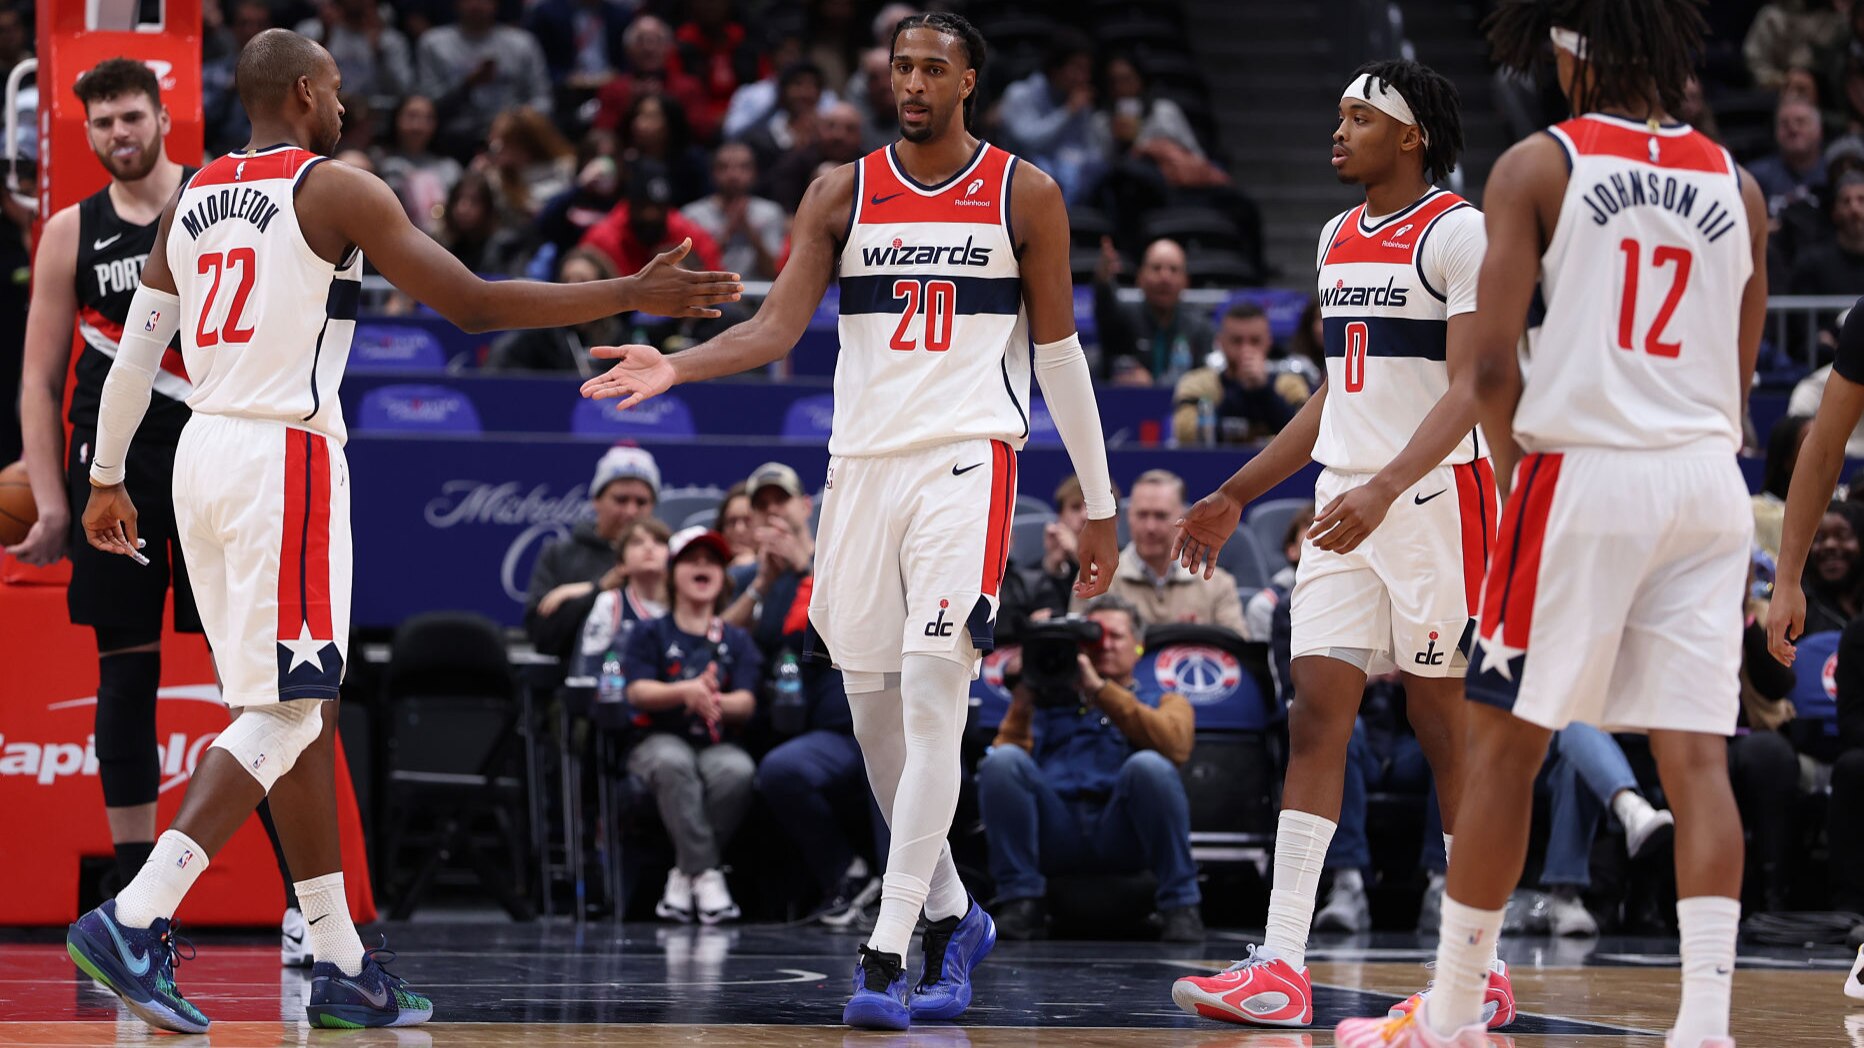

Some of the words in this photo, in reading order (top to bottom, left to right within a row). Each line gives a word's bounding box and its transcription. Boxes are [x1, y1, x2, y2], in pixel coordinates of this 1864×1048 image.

[181, 187, 279, 241] MIDDLETON
[955, 199, 991, 207] Robinhood
[1583, 170, 1697, 226] JOHNSON
[1697, 201, 1735, 243] III
[863, 235, 993, 267] wizards
[1381, 240, 1411, 250] Robinhood
[196, 247, 256, 348] 22
[889, 280, 956, 352] 20
[1320, 276, 1410, 308] wizards
[1618, 238, 1692, 359] 12
[1345, 321, 1368, 393] 0
